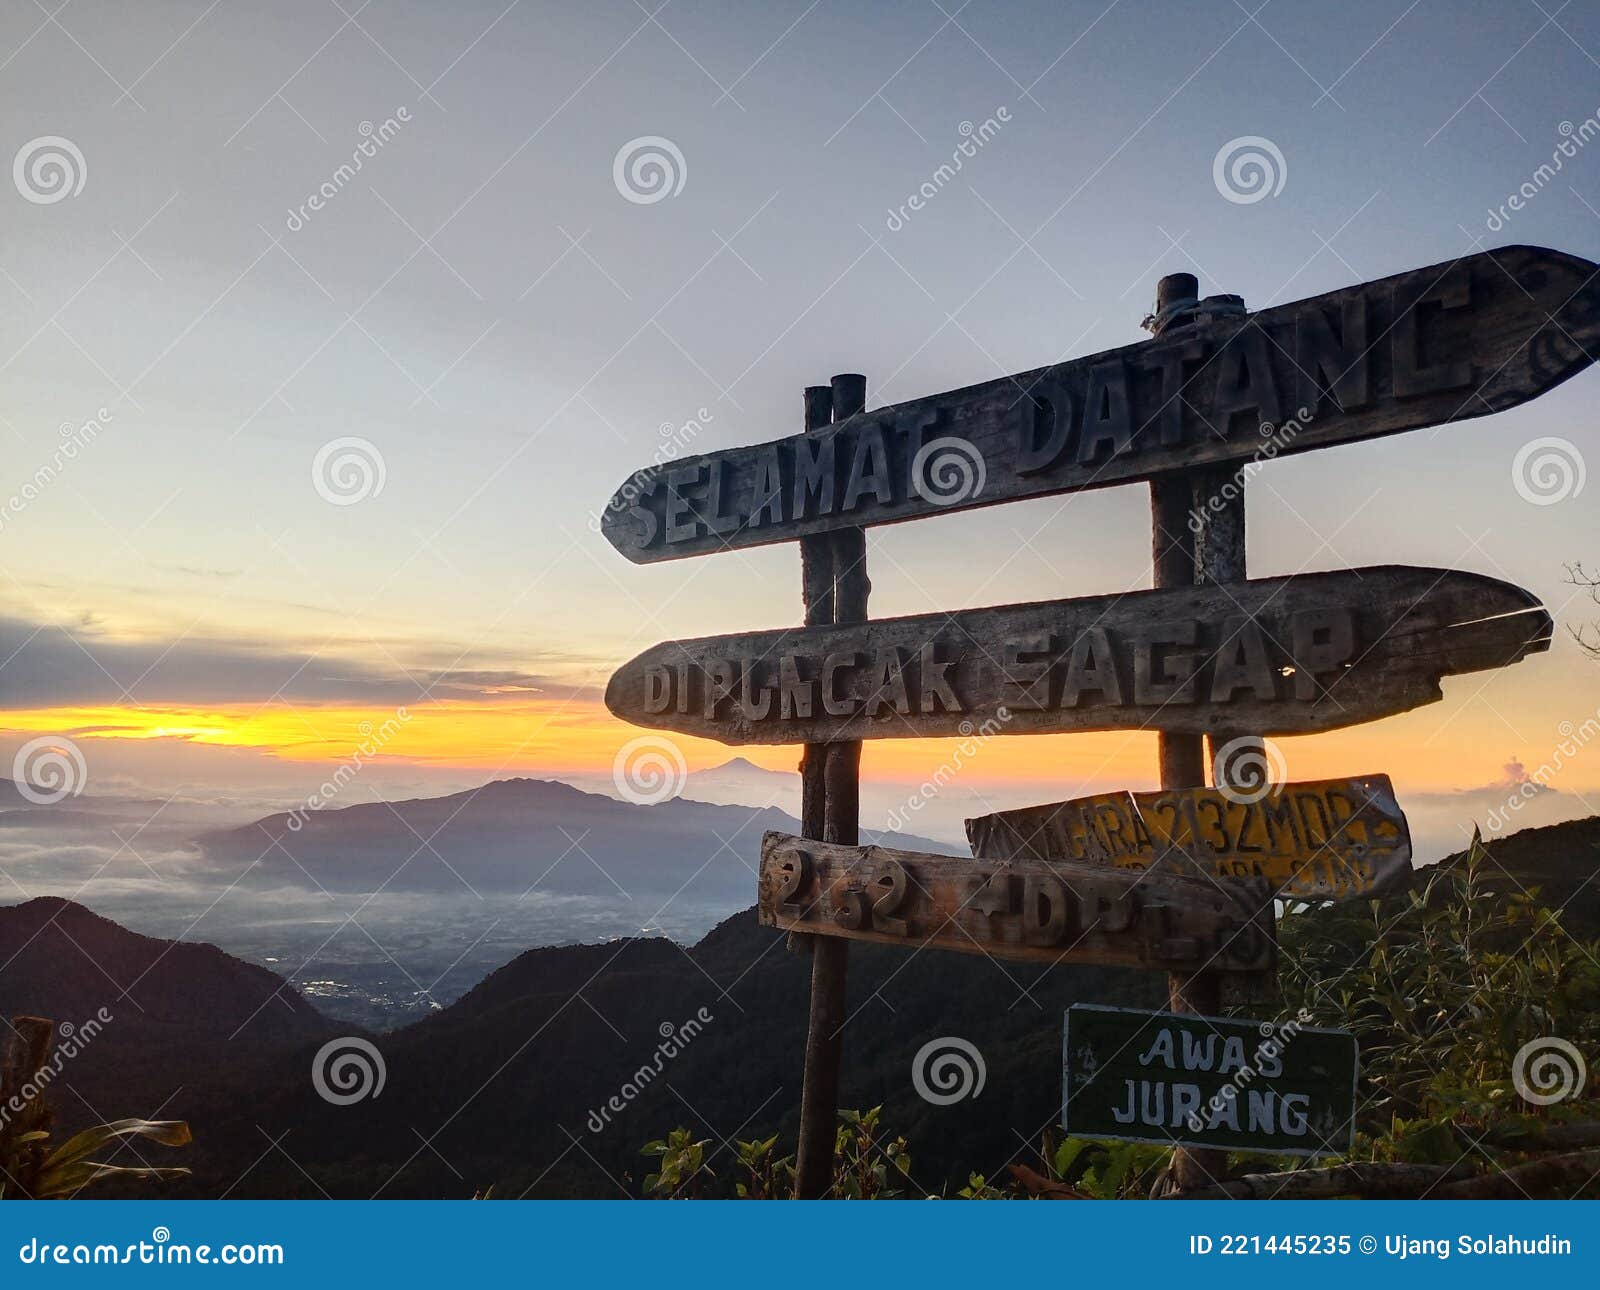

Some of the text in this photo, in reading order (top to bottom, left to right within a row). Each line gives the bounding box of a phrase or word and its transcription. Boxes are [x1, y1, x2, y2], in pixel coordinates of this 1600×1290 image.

[628, 408, 937, 548] SELAMAT
[1138, 1027, 1284, 1079] AWAS
[1111, 1079, 1310, 1136] JURANG
